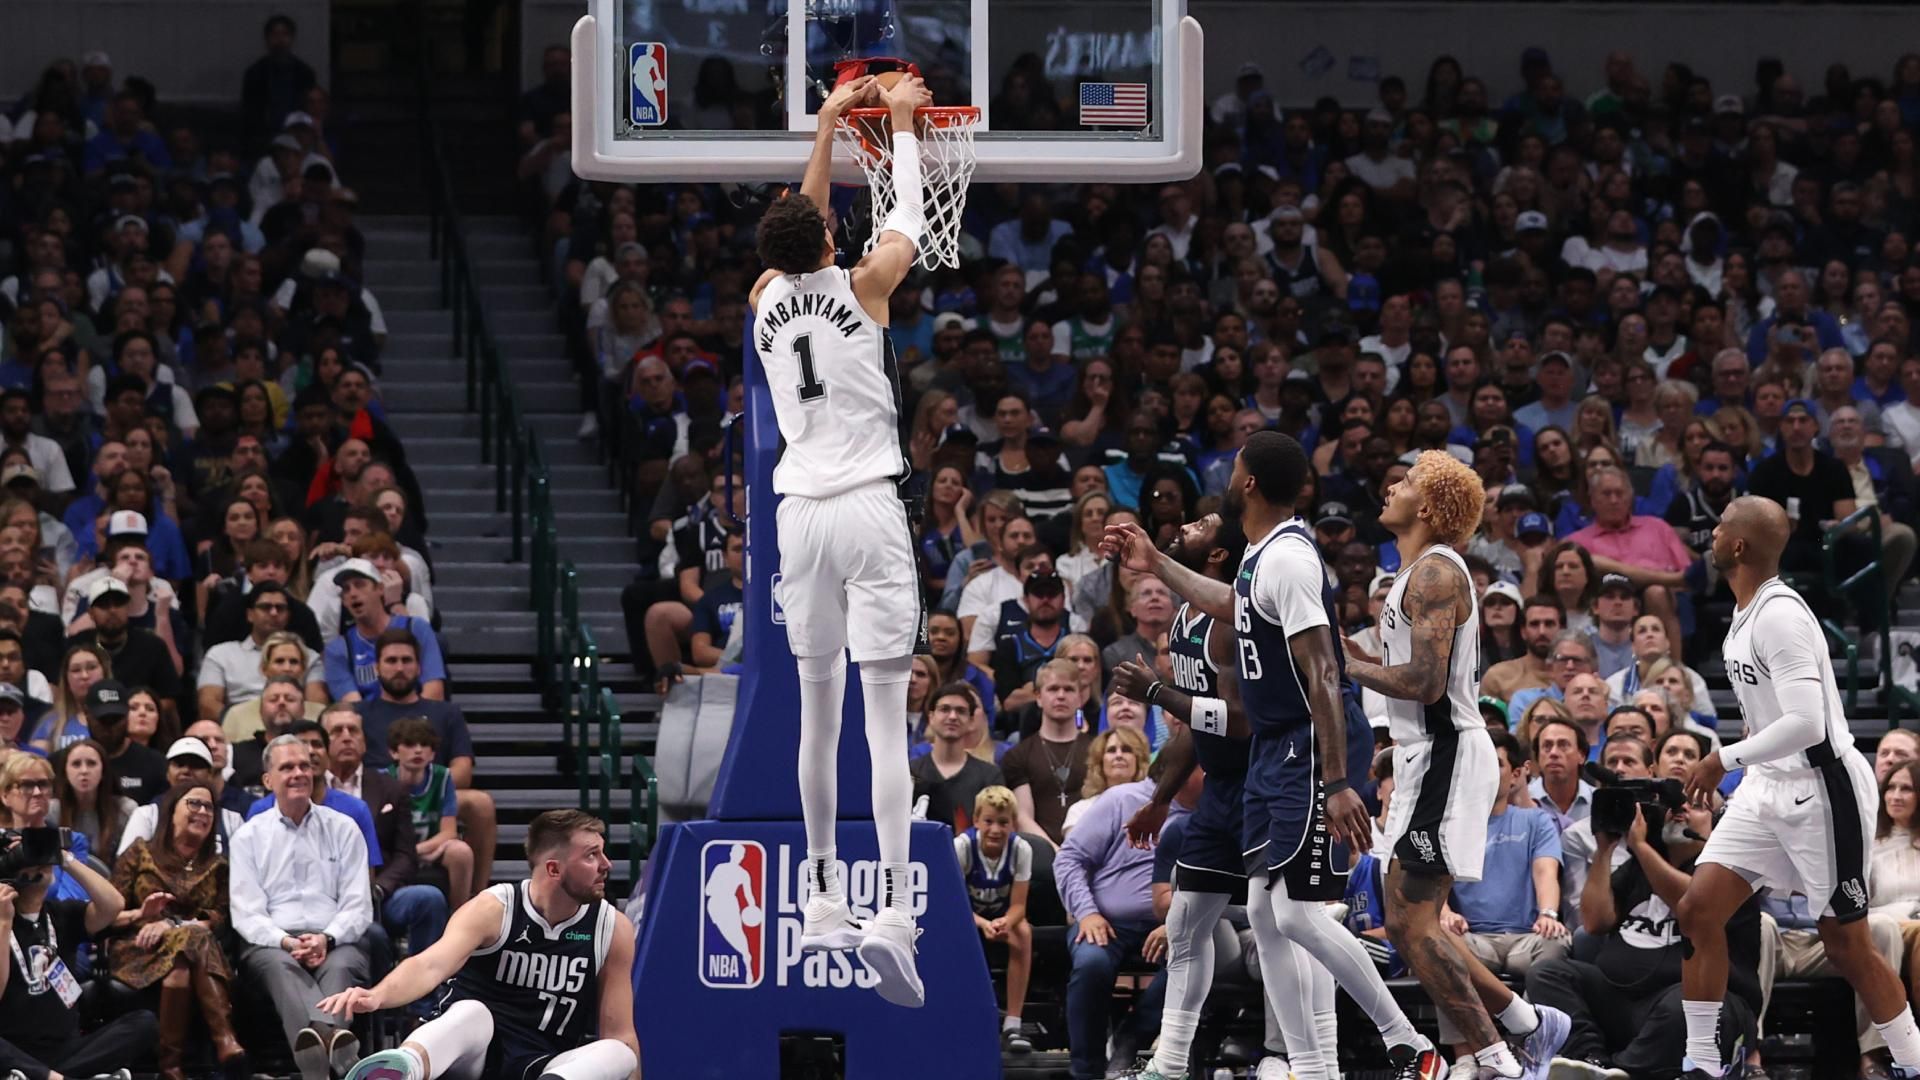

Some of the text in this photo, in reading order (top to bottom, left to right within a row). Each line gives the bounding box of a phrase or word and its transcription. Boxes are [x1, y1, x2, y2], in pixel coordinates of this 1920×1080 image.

[636, 107, 653, 120] NBA
[760, 293, 862, 353] WEMBANYAMA
[791, 332, 827, 403] 1
[1238, 637, 1263, 680] 13
[565, 931, 592, 941] chime
[709, 954, 739, 978] NBA
[538, 991, 578, 1036] 77
